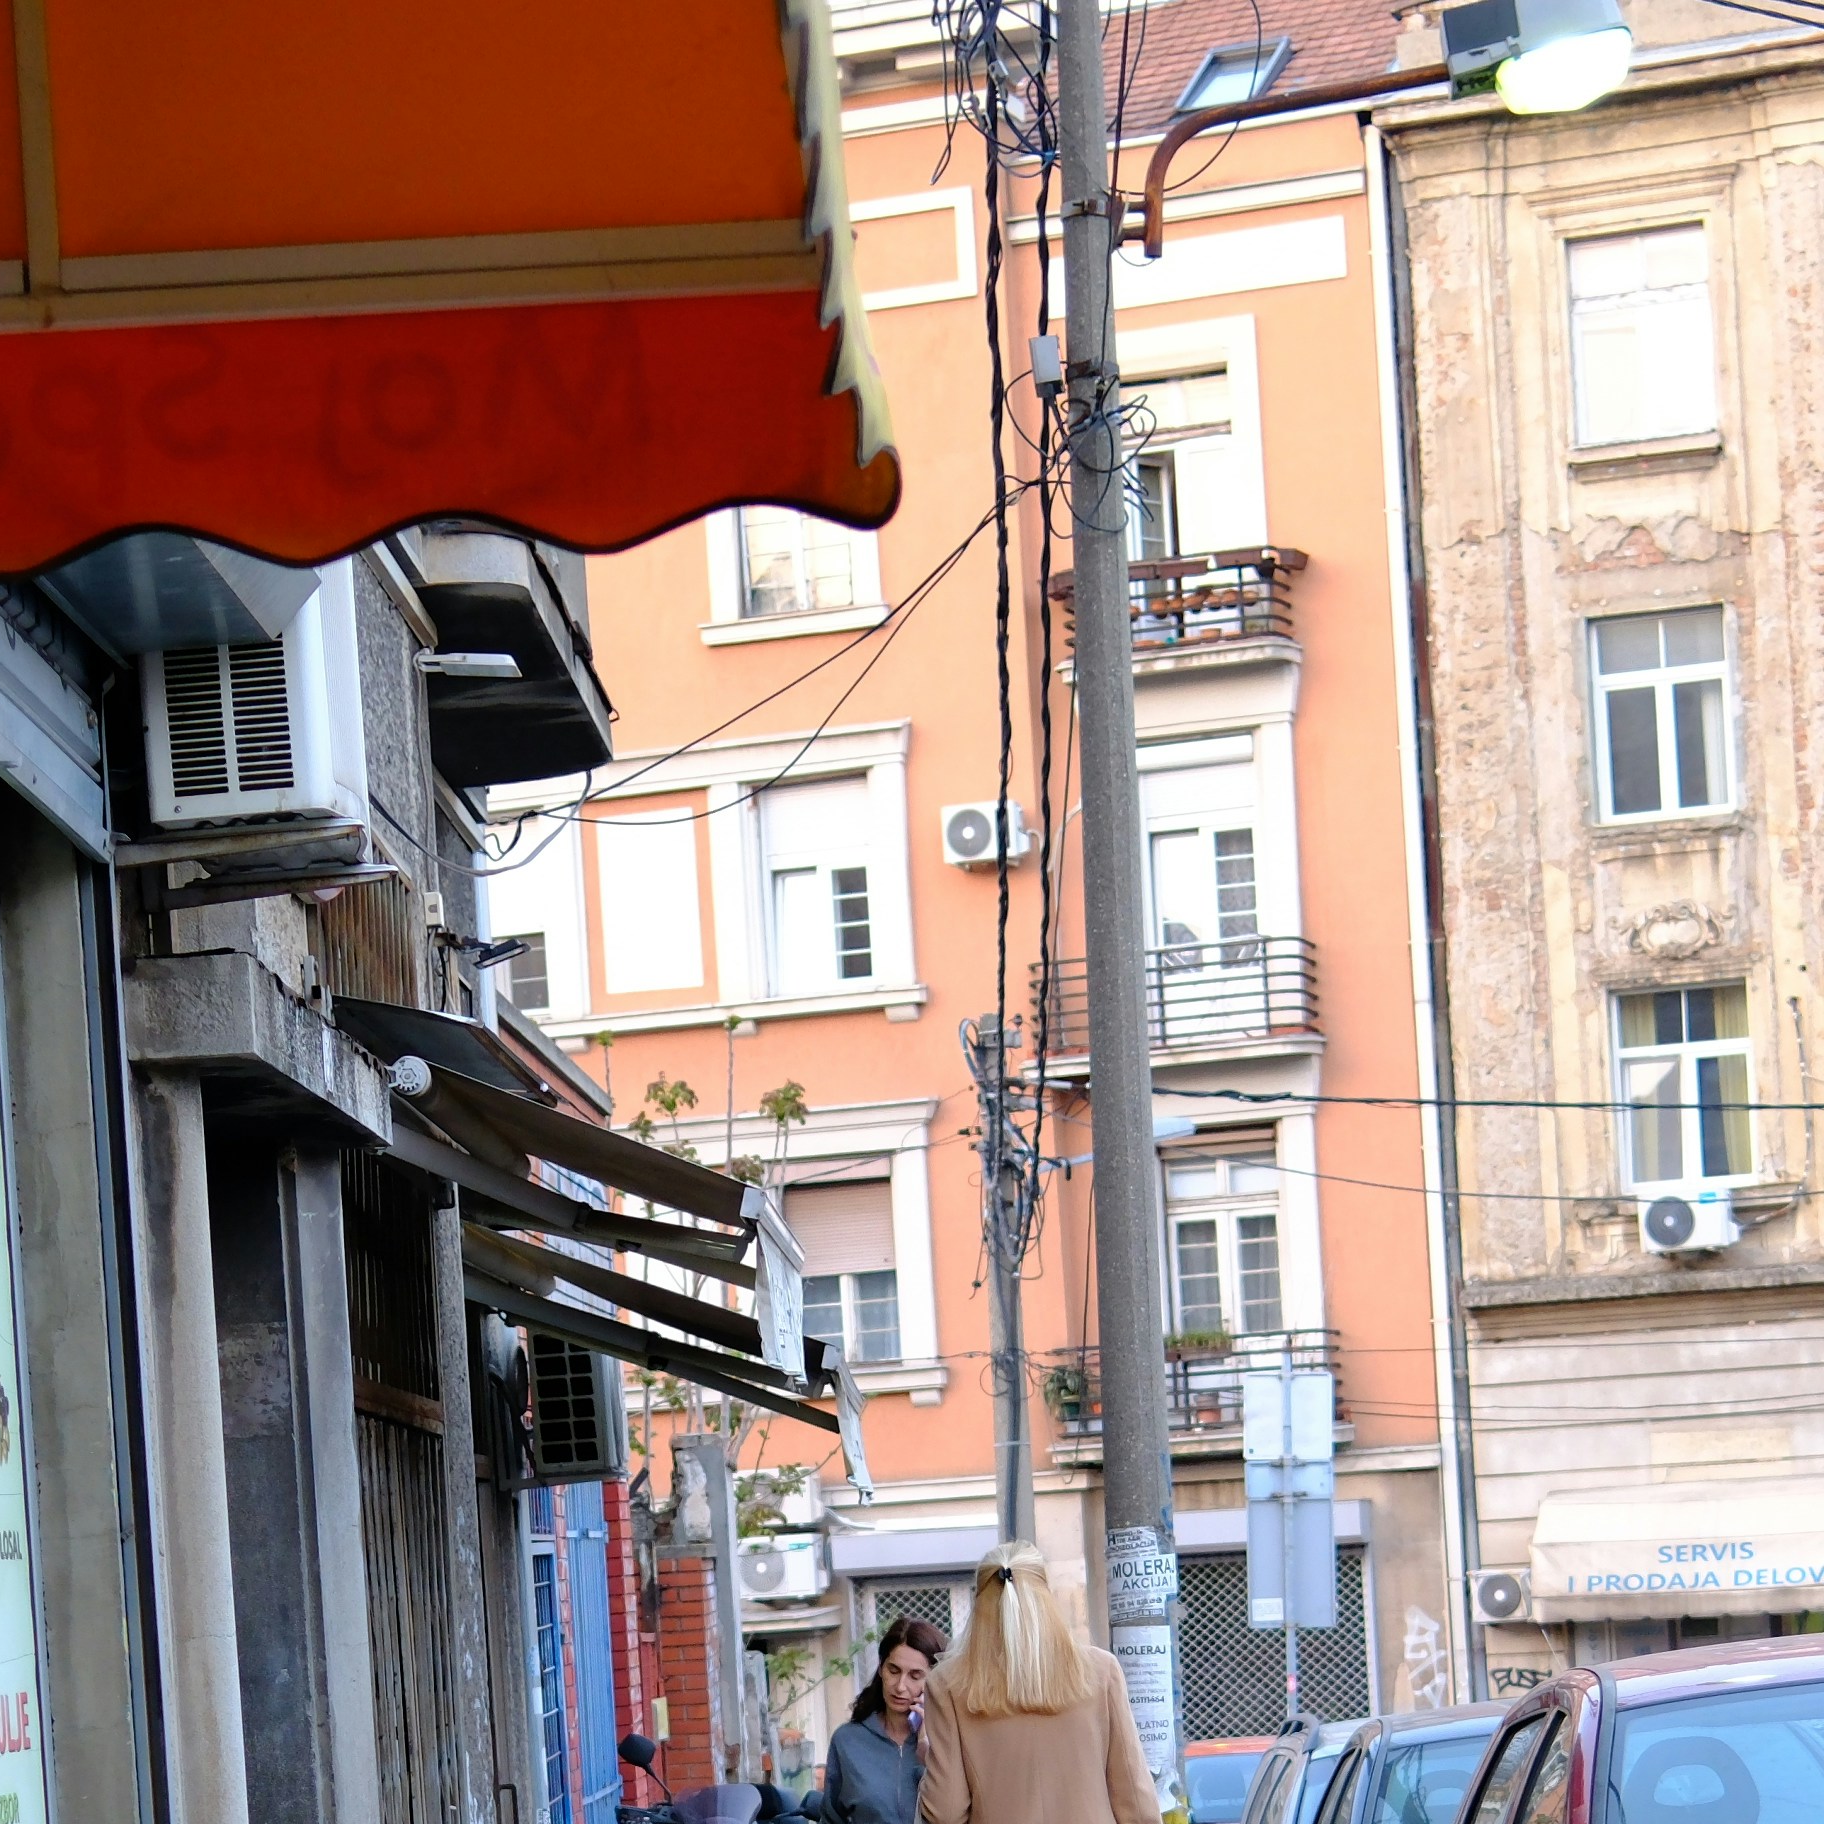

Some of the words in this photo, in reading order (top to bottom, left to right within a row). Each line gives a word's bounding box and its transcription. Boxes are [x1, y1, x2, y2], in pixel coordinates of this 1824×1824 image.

[1657, 1541, 1754, 1563] SERVIS
[1121, 1575, 1173, 1591] AKCIJA!
[1567, 1575, 1575, 1593] I
[1586, 1570, 1721, 1593] PRODAJA
[1117, 1645, 1167, 1656] MOLERAJ
